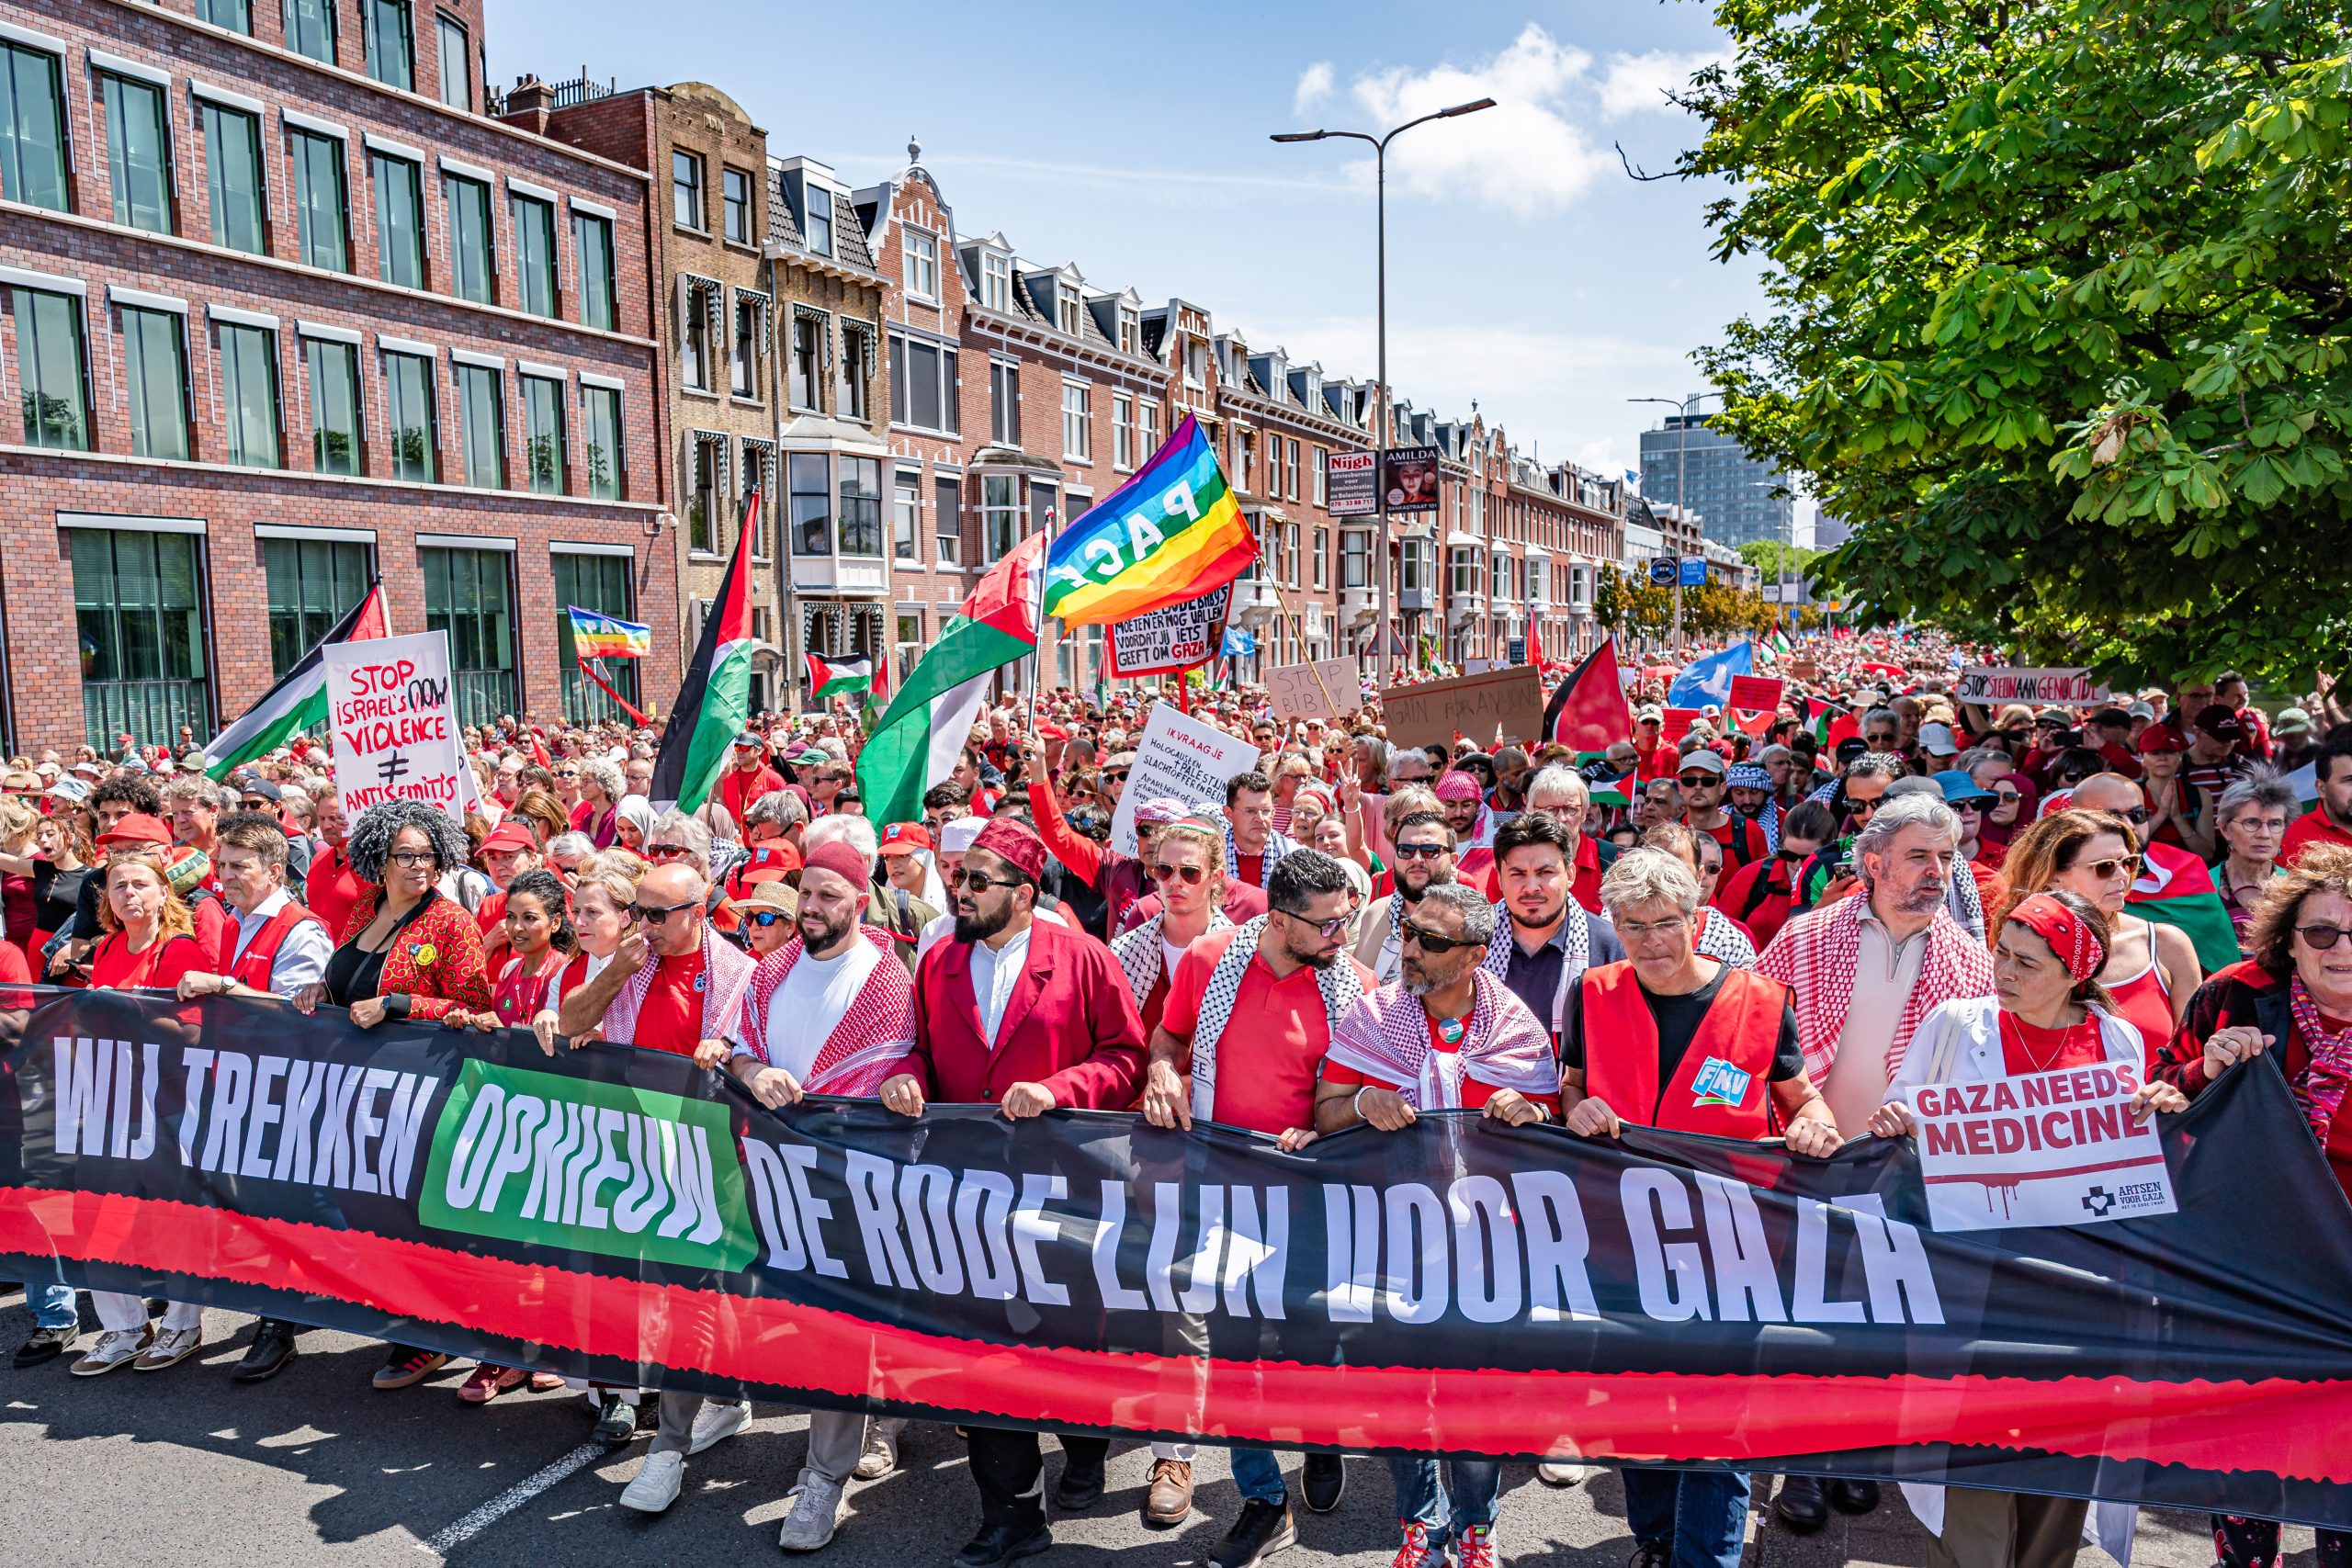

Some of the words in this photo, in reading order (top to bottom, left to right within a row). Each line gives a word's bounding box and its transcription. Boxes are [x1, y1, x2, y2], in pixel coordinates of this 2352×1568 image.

[1330, 455, 1373, 469] Nijgh
[1386, 449, 1437, 462] AMILDA
[1330, 471, 1373, 479] Adviesbureau
[1330, 483, 1374, 492] Administraties
[1338, 491, 1374, 500] Belastingen
[1387, 503, 1428, 512] BANKASTRAAT
[1115, 616, 1151, 635] MOETEN
[1152, 615, 1165, 629] ER
[1166, 613, 1187, 627] NOG
[1190, 605, 1224, 625] VALLEN
[1116, 631, 1158, 649] VOORDAT
[1117, 648, 1149, 667] GEEFT
[1152, 646, 1170, 661] OM
[1171, 640, 1204, 660] GAZA
[350, 660, 415, 696] STOP
[1277, 663, 1342, 693] STOP
[1962, 673, 1988, 697] STOP
[2016, 677, 2037, 700] AAN
[341, 716, 448, 757] VIOLENCE
[1166, 727, 1176, 739] IK
[1177, 731, 1212, 755] VRAAG
[1143, 754, 1196, 790] SLACHTOFFER
[1697, 1065, 1748, 1095] FNV
[1916, 1082, 2020, 1118] GAZA
[2021, 1064, 2139, 1110] NEEDS
[1924, 1102, 2151, 1156] MEDICINE
[53, 1036, 161, 1160] WIJ
[178, 1047, 440, 1200] TREKKEN
[445, 1083, 725, 1246] OPNIEUW
[741, 1135, 849, 1280] DE
[844, 1148, 1071, 1306] RODE
[1093, 1179, 1290, 1320] LIJN
[1323, 1169, 1602, 1324] VOOR
[1619, 1168, 1947, 1325] GAZA
[2119, 1181, 2162, 1196] ARTSEN
[2120, 1195, 2142, 1204] VOOR
[2142, 1192, 2165, 1202] GAZA
